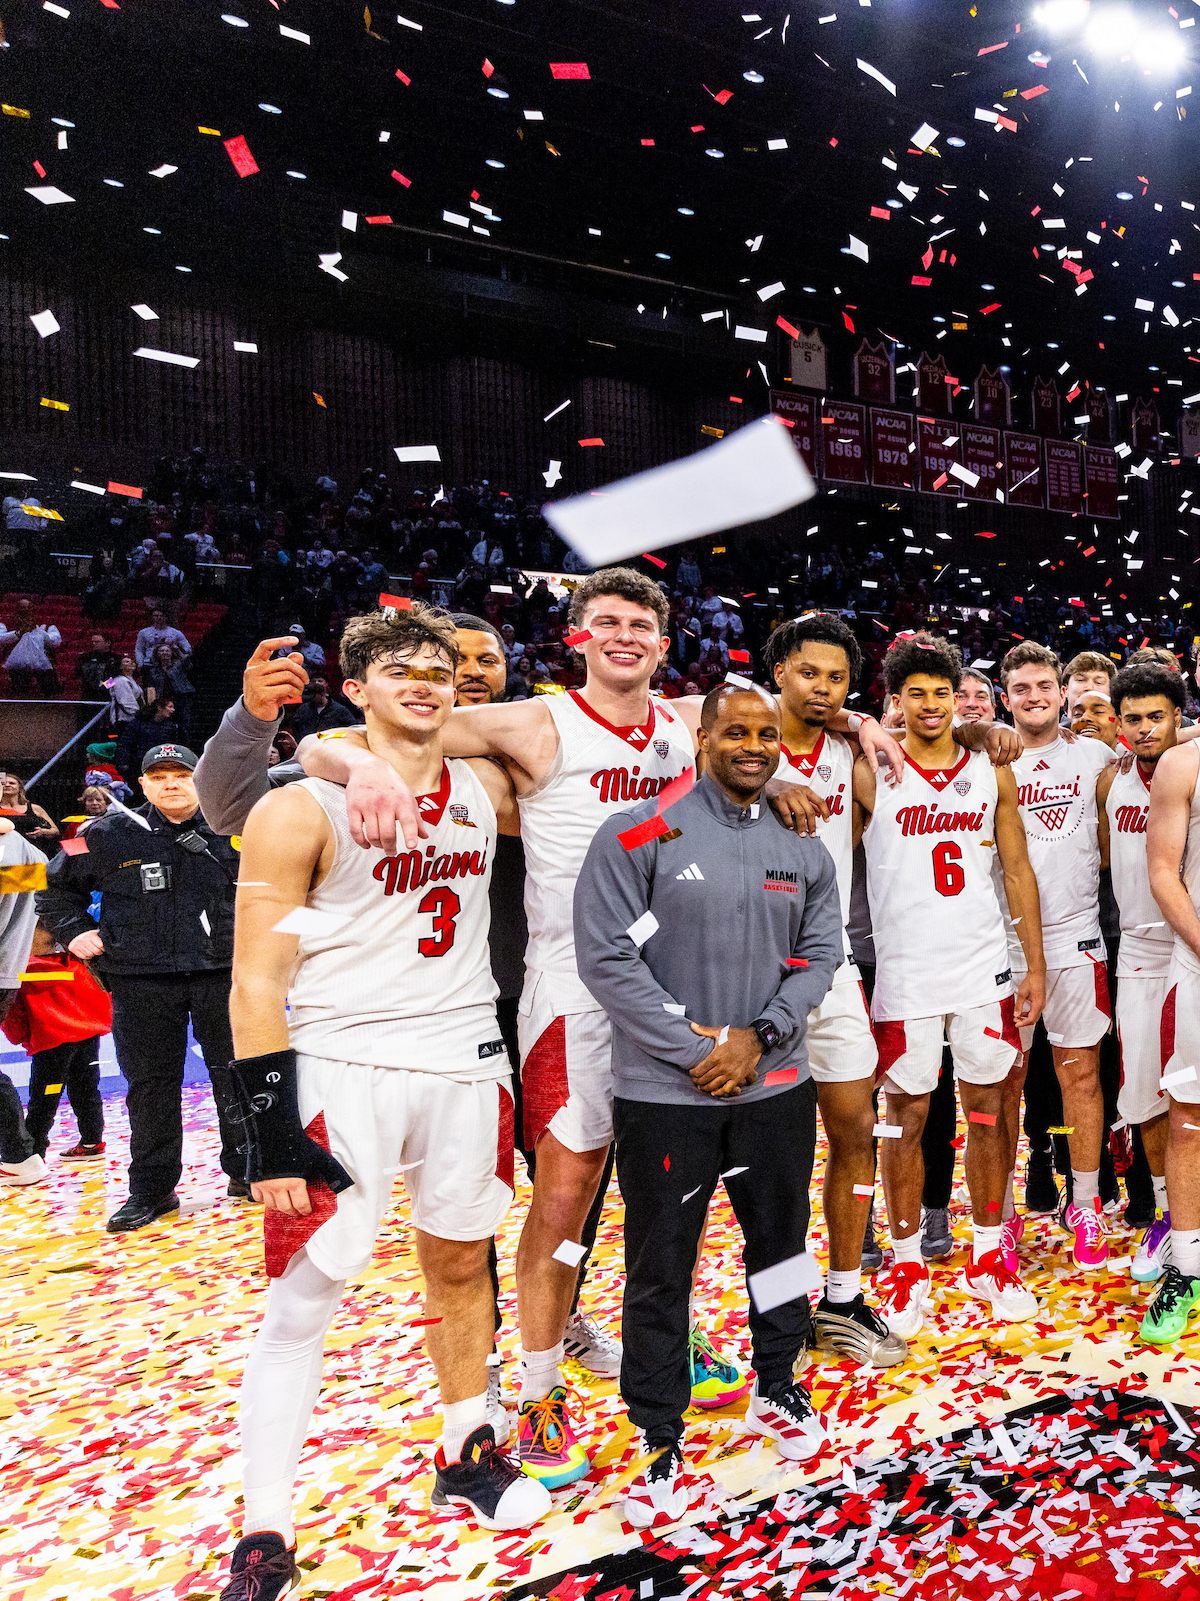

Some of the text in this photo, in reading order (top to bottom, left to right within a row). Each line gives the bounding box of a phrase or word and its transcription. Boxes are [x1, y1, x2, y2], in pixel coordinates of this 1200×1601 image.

[793, 340, 822, 353] CUSICK
[804, 352, 812, 363] 5
[868, 363, 881, 376] 32
[929, 372, 940, 385] 12
[986, 387, 998, 398] 10
[776, 398, 809, 414] NCAA
[1040, 396, 1052, 408] 23
[828, 408, 859, 422] NCAA
[876, 417, 906, 430] NCAA
[923, 424, 953, 438] NIT
[793, 434, 811, 451] 58
[967, 432, 994, 445] NCAA
[829, 441, 862, 459] 1969
[1010, 439, 1037, 452] NCAA
[878, 449, 908, 466] 1978
[1051, 447, 1077, 459] NCAA
[1089, 453, 1115, 465] NIT
[967, 461, 996, 479] 1995
[154, 752, 184, 760] POLICE
[895, 802, 988, 837] Miami
[372, 836, 489, 896] Miami
[932, 841, 966, 897] 6
[765, 869, 797, 883] MIAMI
[762, 883, 799, 894] BASKETBALL
[418, 886, 461, 958] 3
